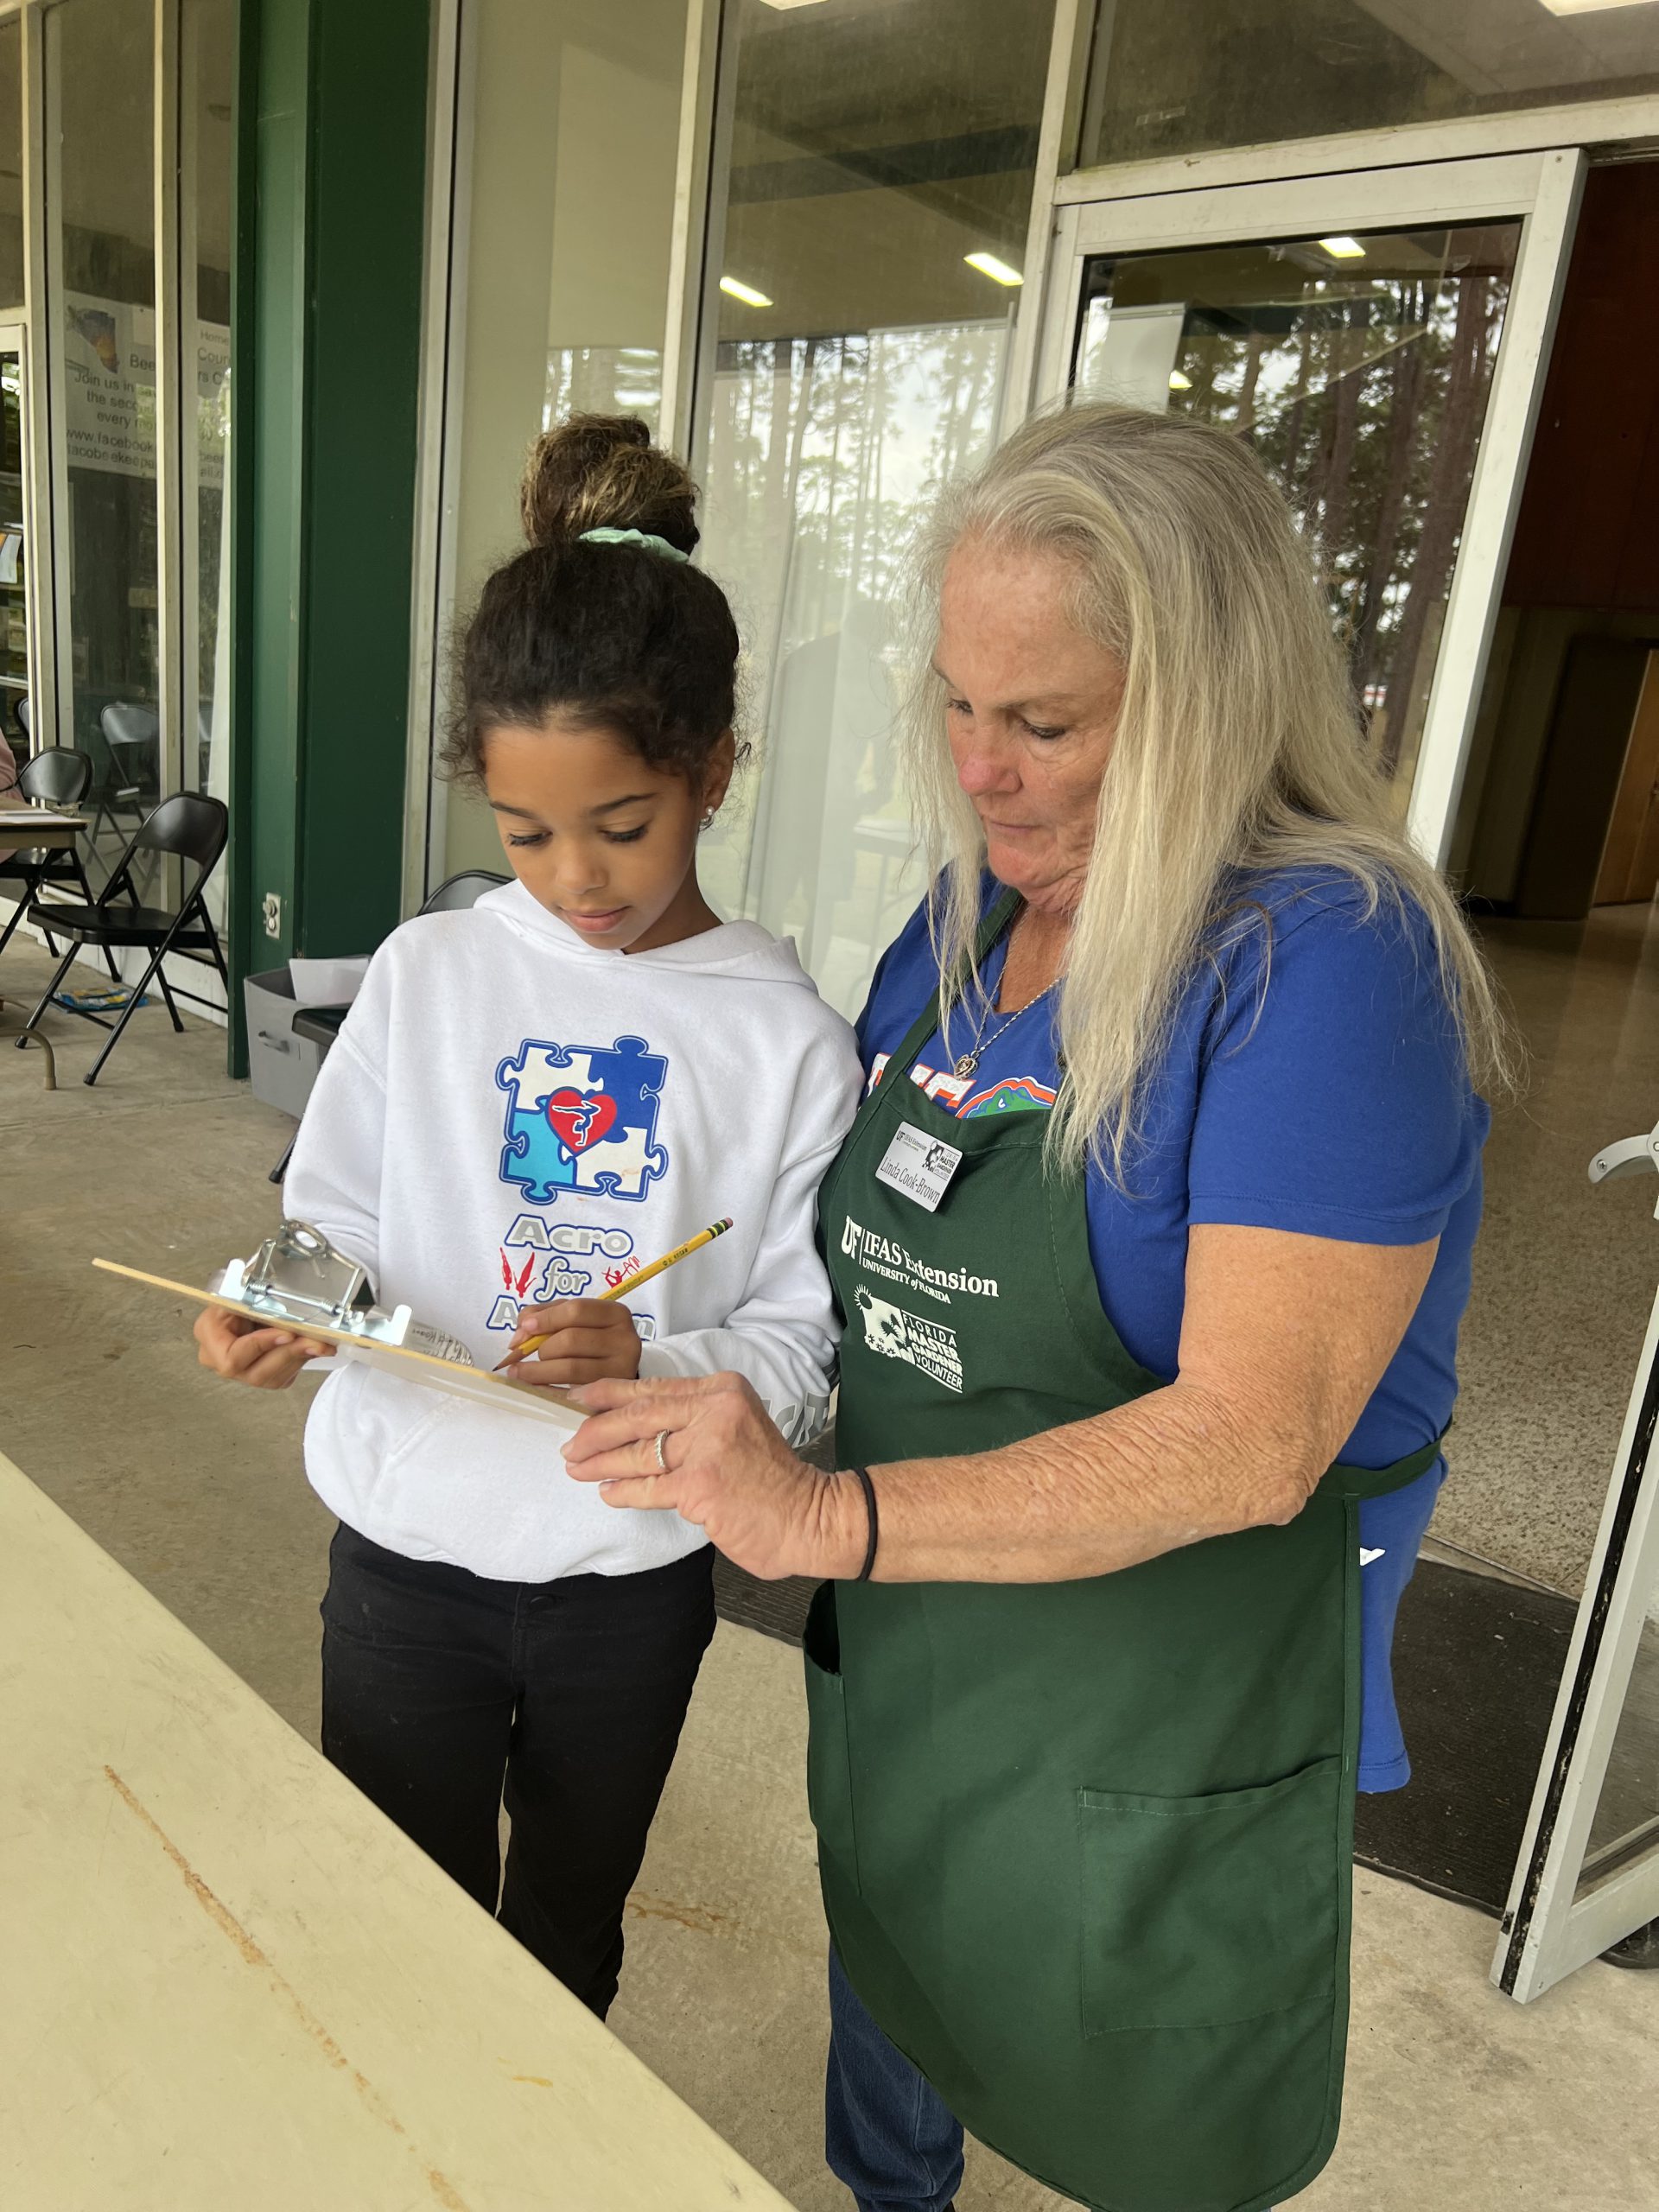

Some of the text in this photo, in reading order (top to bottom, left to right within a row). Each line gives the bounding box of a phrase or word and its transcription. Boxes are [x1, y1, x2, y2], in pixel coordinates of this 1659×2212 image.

[74, 372, 101, 386] Join
[105, 379, 119, 391] us
[86, 390, 106, 405] the
[97, 412, 130, 429] every
[896, 1130, 906, 1141] UF
[940, 1155, 957, 1169] MASTER
[880, 1156, 941, 1205] Linda Cook-Brown
[504, 1213, 634, 1259] Acro
[841, 1215, 1000, 1297] UF IFAS Extension
[533, 1255, 592, 1303] for
[862, 1257, 952, 1304] UNIVERSITY of FLORIDA
[902, 1313, 957, 1348] FLORIDA
[906, 1326, 963, 1363] MASTER
[911, 1342, 963, 1377] GARDENER
[914, 1352, 963, 1389] VOLUNTEER
